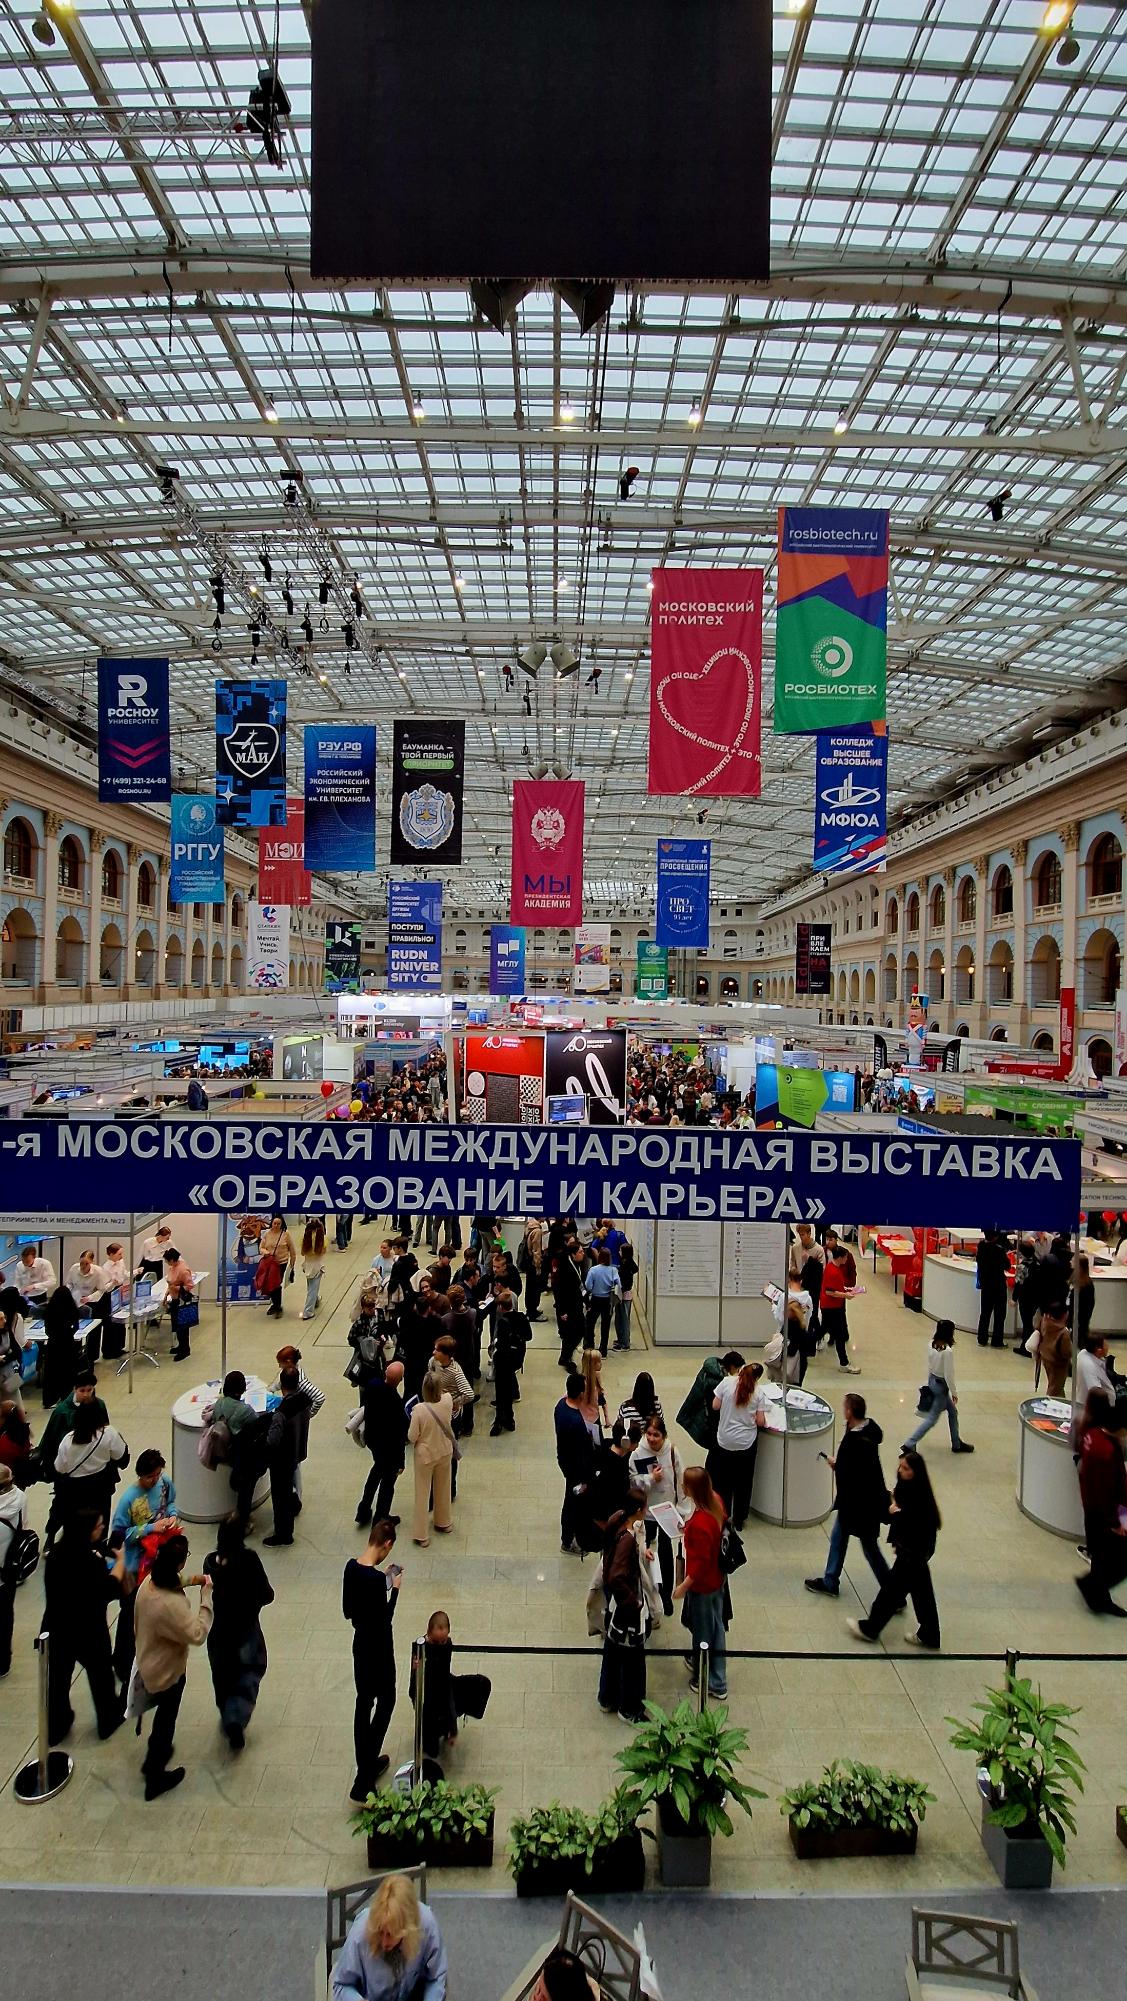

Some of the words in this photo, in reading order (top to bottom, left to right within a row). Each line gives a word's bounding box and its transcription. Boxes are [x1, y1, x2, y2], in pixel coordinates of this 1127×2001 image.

[789, 528, 878, 541] rosbiotech.ru
[784, 683, 877, 694] РОСБИОТЕХ
[107, 708, 159, 718] РОСНОУ
[318, 742, 362, 751] РЭУ.РФ
[696, 736, 730, 753] ПОЛИТЕХ
[830, 738, 874, 747] КОЛЛЕДЖ
[400, 751, 421, 759] ТВОЙ
[422, 751, 454, 759] ПЕРВЫЙ
[833, 750, 870, 758] ВЫСШЕЕ
[820, 758, 883, 766] ОБРАЗОВАНИЕ
[112, 777, 131, 785] (499)
[820, 812, 880, 828] МФЮА
[174, 843, 221, 860] РГГУ
[660, 863, 708, 871] ПРОСВЕЩЕНИЯ
[524, 874, 571, 894] МЫ
[524, 900, 571, 908] АКАДЕМИЯ
[391, 950, 428, 960] RUDN
[391, 962, 439, 972] UNIVER
[391, 973, 419, 983] SITY
[58, 1124, 372, 1160] МОСКОВСКАЯ
[388, 1129, 794, 1174] МЕЖДУНАРОДНАЯ
[810, 1140, 1064, 1181] ВЫСТАВКА
[188, 1174, 544, 1212] «ОБРАЗОВАНИЕ
[560, 1180, 586, 1213] И
[602, 1182, 826, 1220] КАРЬЕРА»
